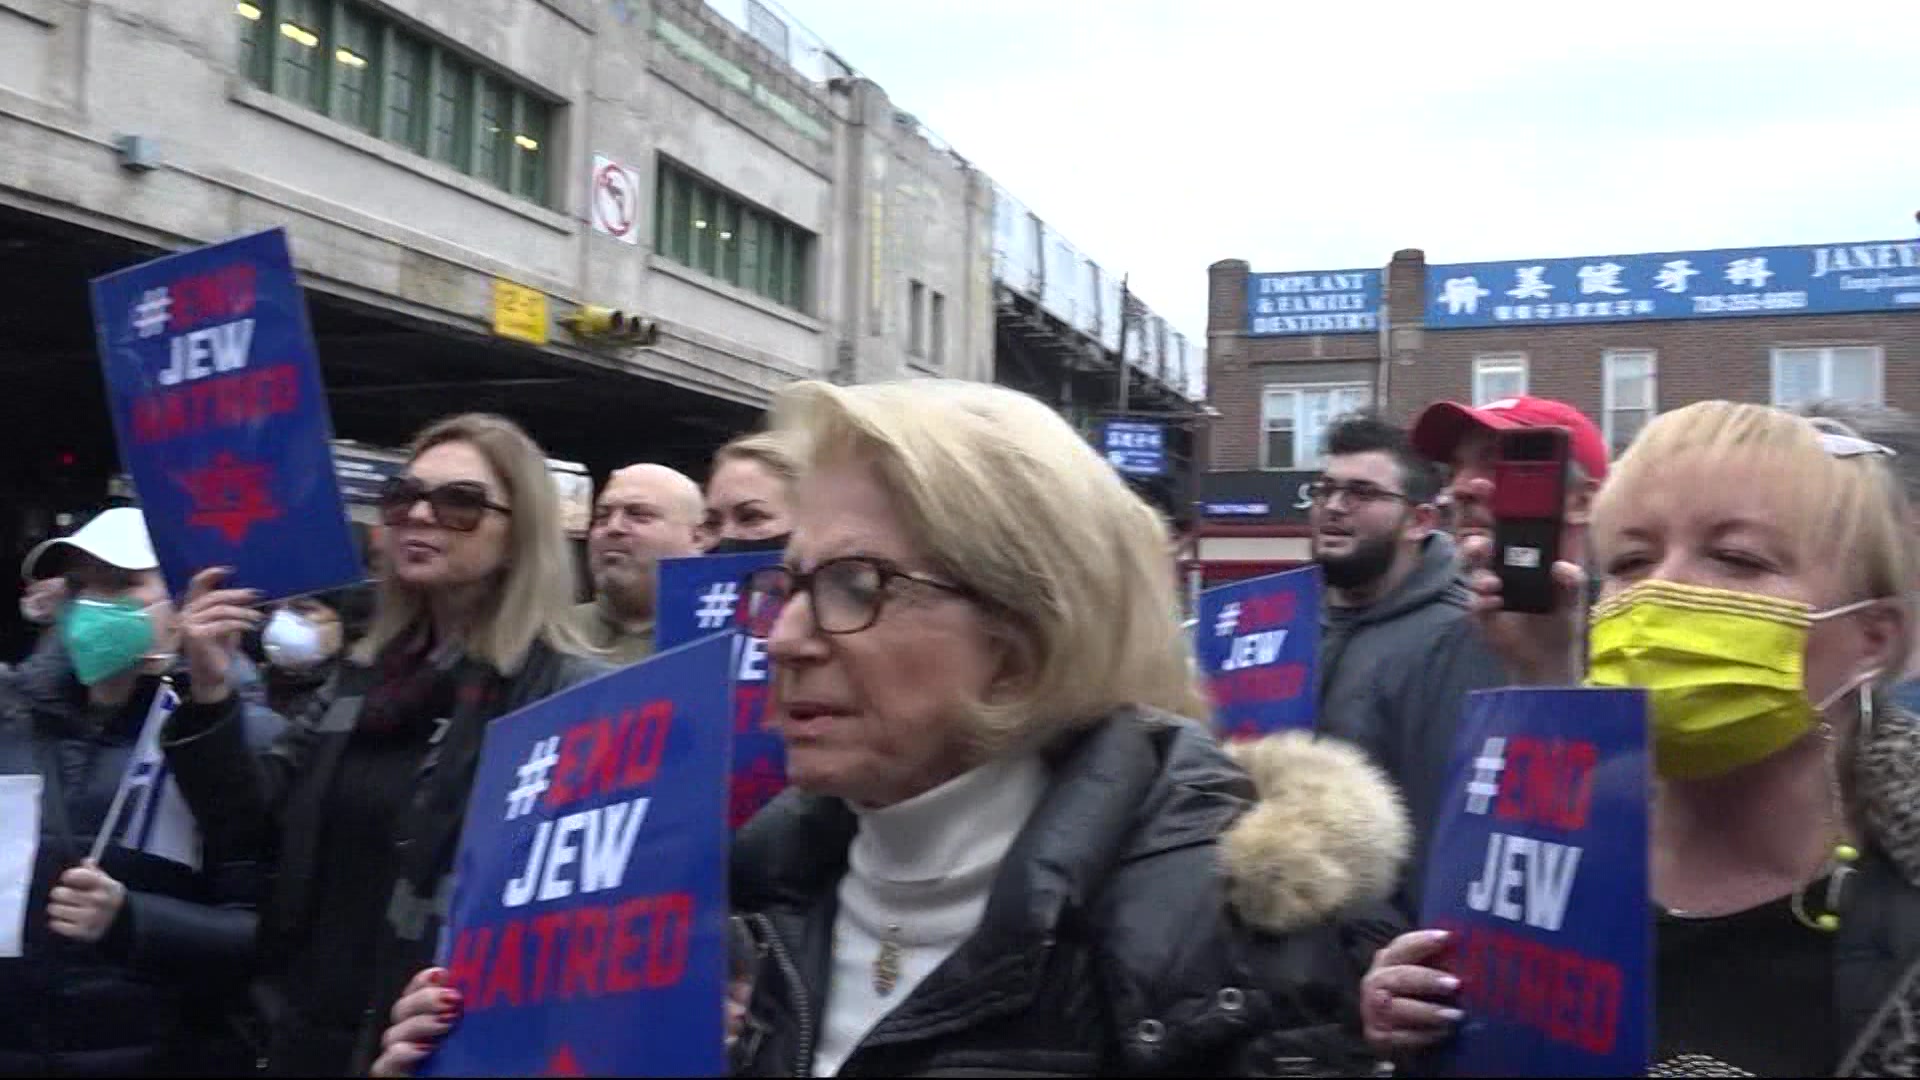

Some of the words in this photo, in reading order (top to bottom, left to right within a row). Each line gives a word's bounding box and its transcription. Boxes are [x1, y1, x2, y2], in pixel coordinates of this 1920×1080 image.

[1253, 312, 1377, 333] DENTISTRY
[1259, 274, 1365, 293] IMPLANT
[1278, 293, 1367, 312] FAMILY
[159, 319, 256, 386] JEW
[1221, 628, 1289, 671] JEW
[504, 701, 673, 821] #END
[1464, 734, 1597, 831] #END
[502, 797, 652, 908] JEW
[1466, 831, 1584, 932] JEW
[449, 892, 693, 1010] HATRED
